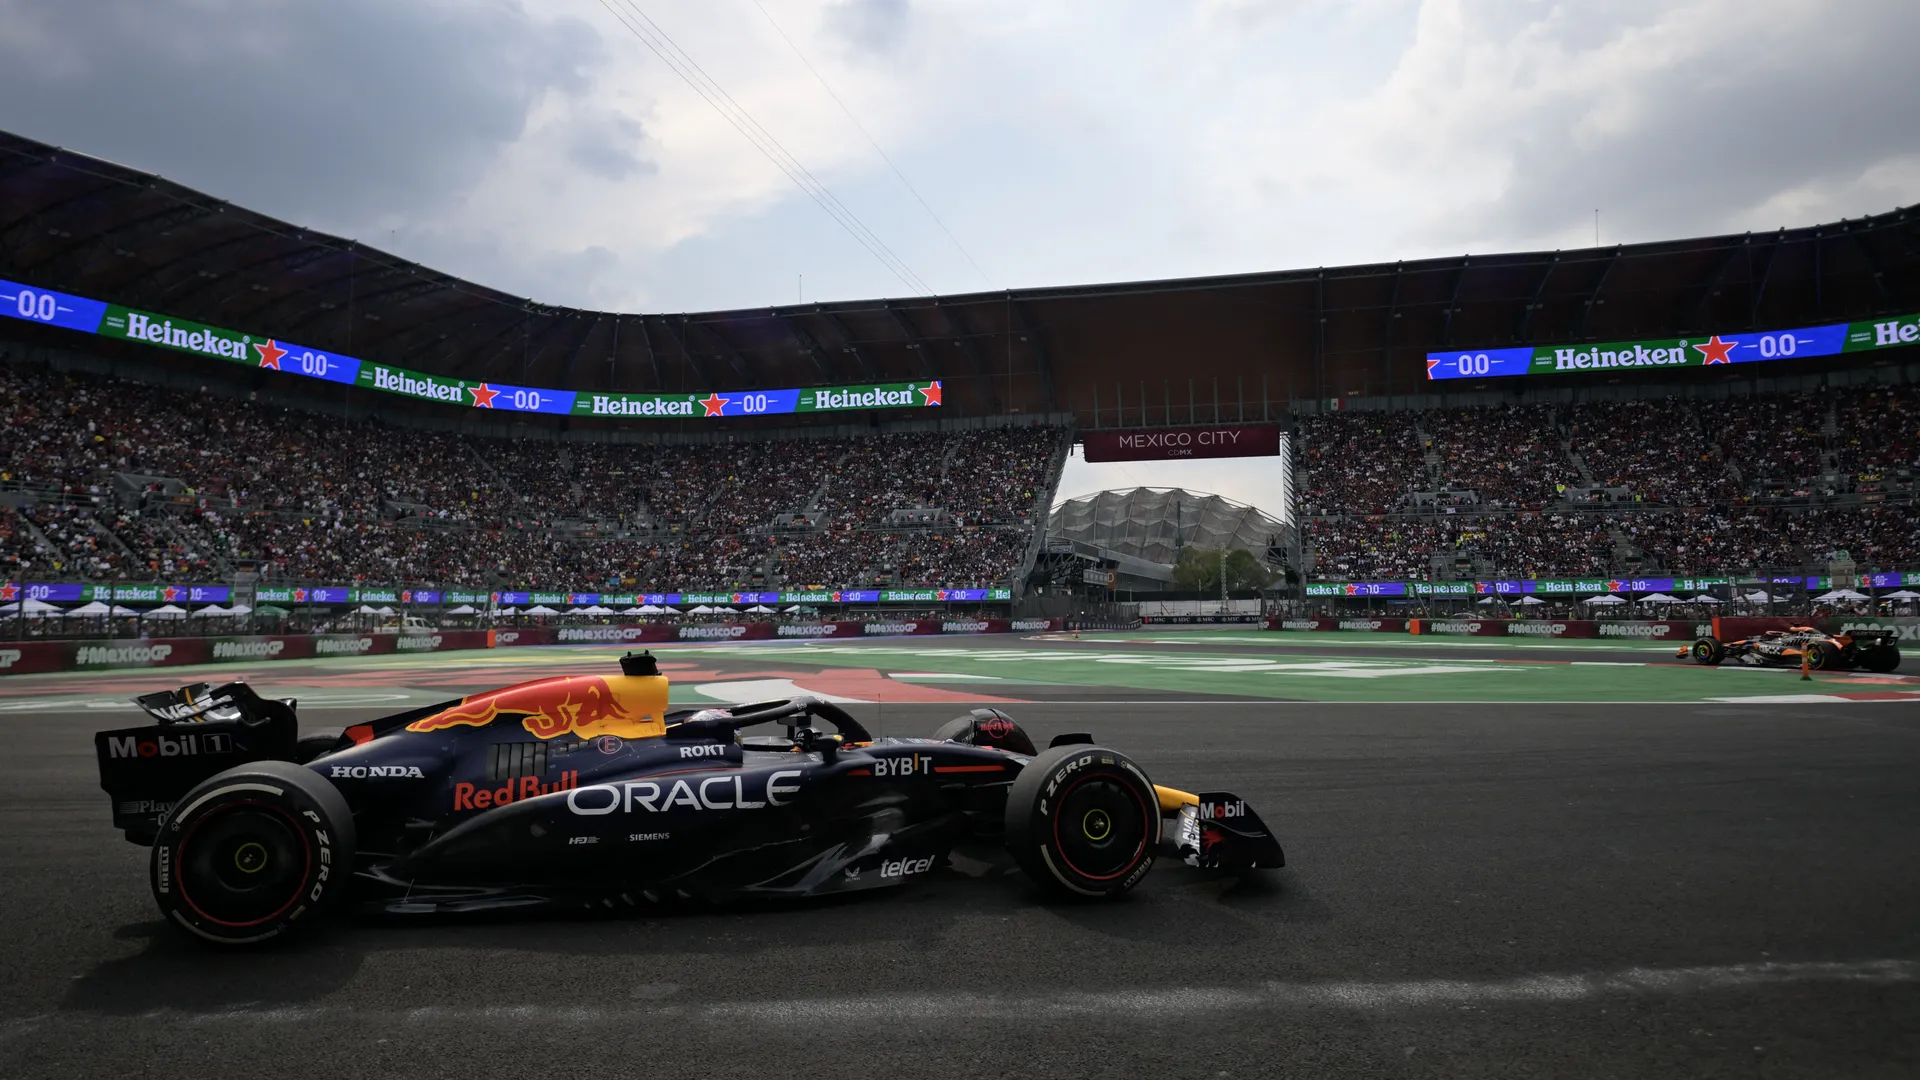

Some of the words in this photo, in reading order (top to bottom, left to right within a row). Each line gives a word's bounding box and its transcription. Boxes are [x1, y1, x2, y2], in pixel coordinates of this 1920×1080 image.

[126, 312, 248, 360] Heineken
[1554, 345, 1686, 370] Heineken
[374, 366, 463, 402] Heineken
[592, 396, 694, 416] Heineken
[816, 388, 912, 410] Heineken
[1119, 432, 1191, 448] MEXICO
[1198, 430, 1240, 445] CITY
[108, 735, 197, 758] Mobil
[680, 744, 726, 758] ROKT
[330, 766, 424, 778] HONDA
[874, 753, 932, 776] BYBIT
[454, 778, 514, 810] Red
[518, 770, 578, 800] Bull
[566, 770, 802, 816] ORACLE
[1040, 798, 1048, 816] P
[1046, 755, 1092, 798] ZERO
[303, 810, 320, 824] P
[1200, 800, 1244, 820] Mobil
[629, 832, 670, 842] SIEMENS
[158, 846, 170, 893] PIRELLI
[310, 829, 331, 902] ZERO
[880, 854, 936, 878] telcel
